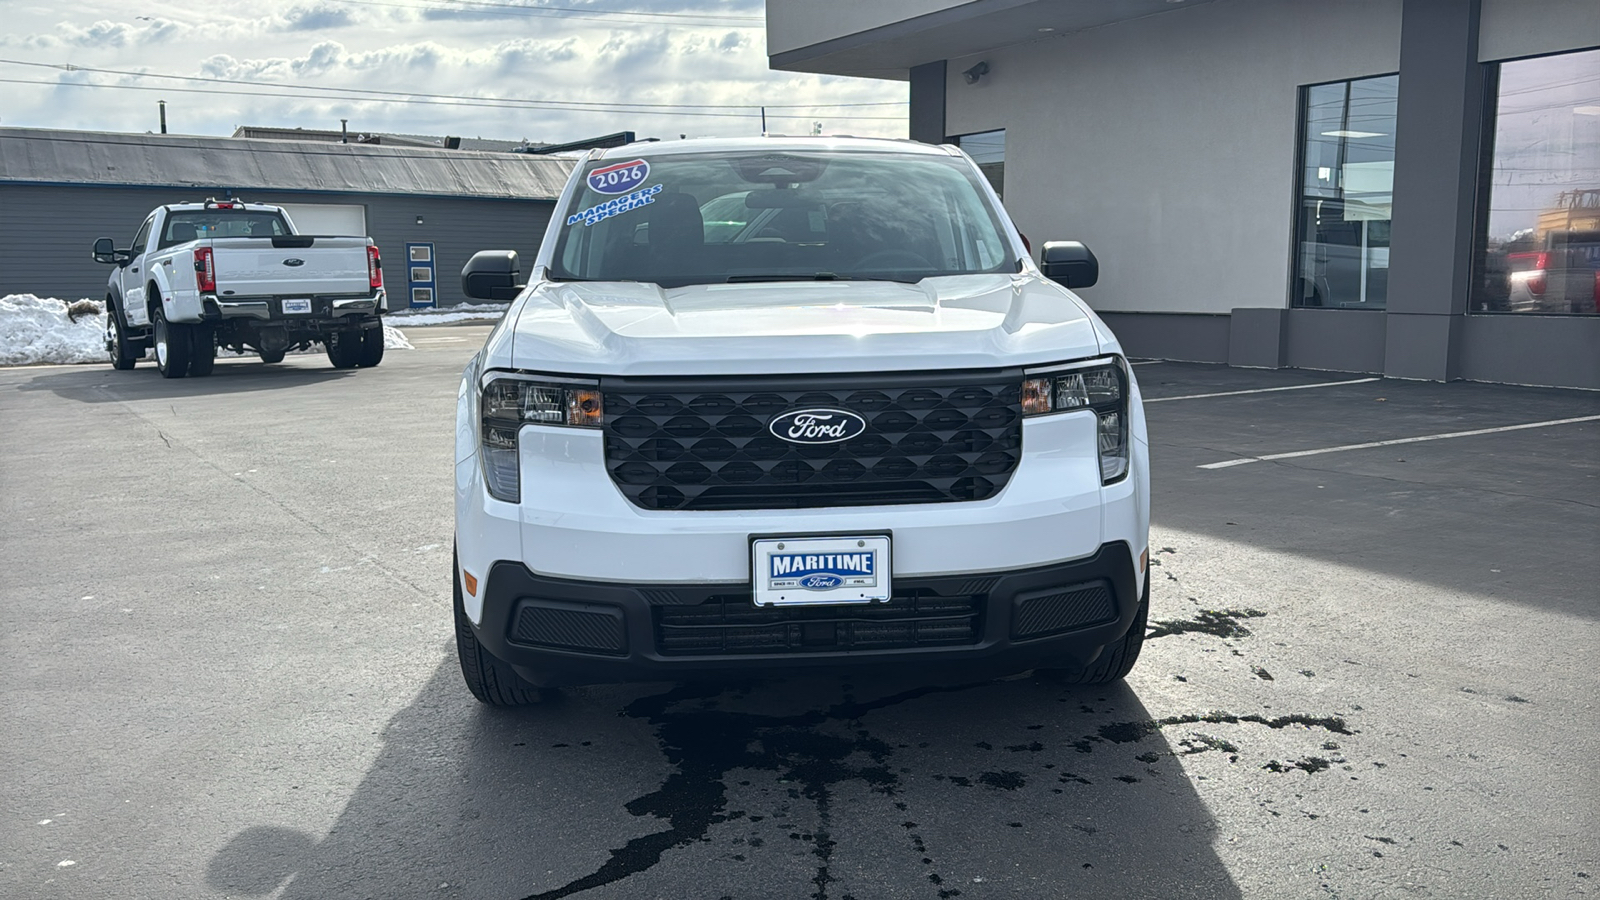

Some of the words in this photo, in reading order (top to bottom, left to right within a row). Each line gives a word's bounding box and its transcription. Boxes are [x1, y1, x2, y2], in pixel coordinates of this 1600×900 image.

[596, 166, 642, 188] 2026
[568, 184, 663, 224] MANAGERS
[586, 196, 655, 225] SPECIAL
[787, 413, 848, 439] Ford
[772, 553, 872, 577] MARITIME
[806, 576, 836, 588] Ford
